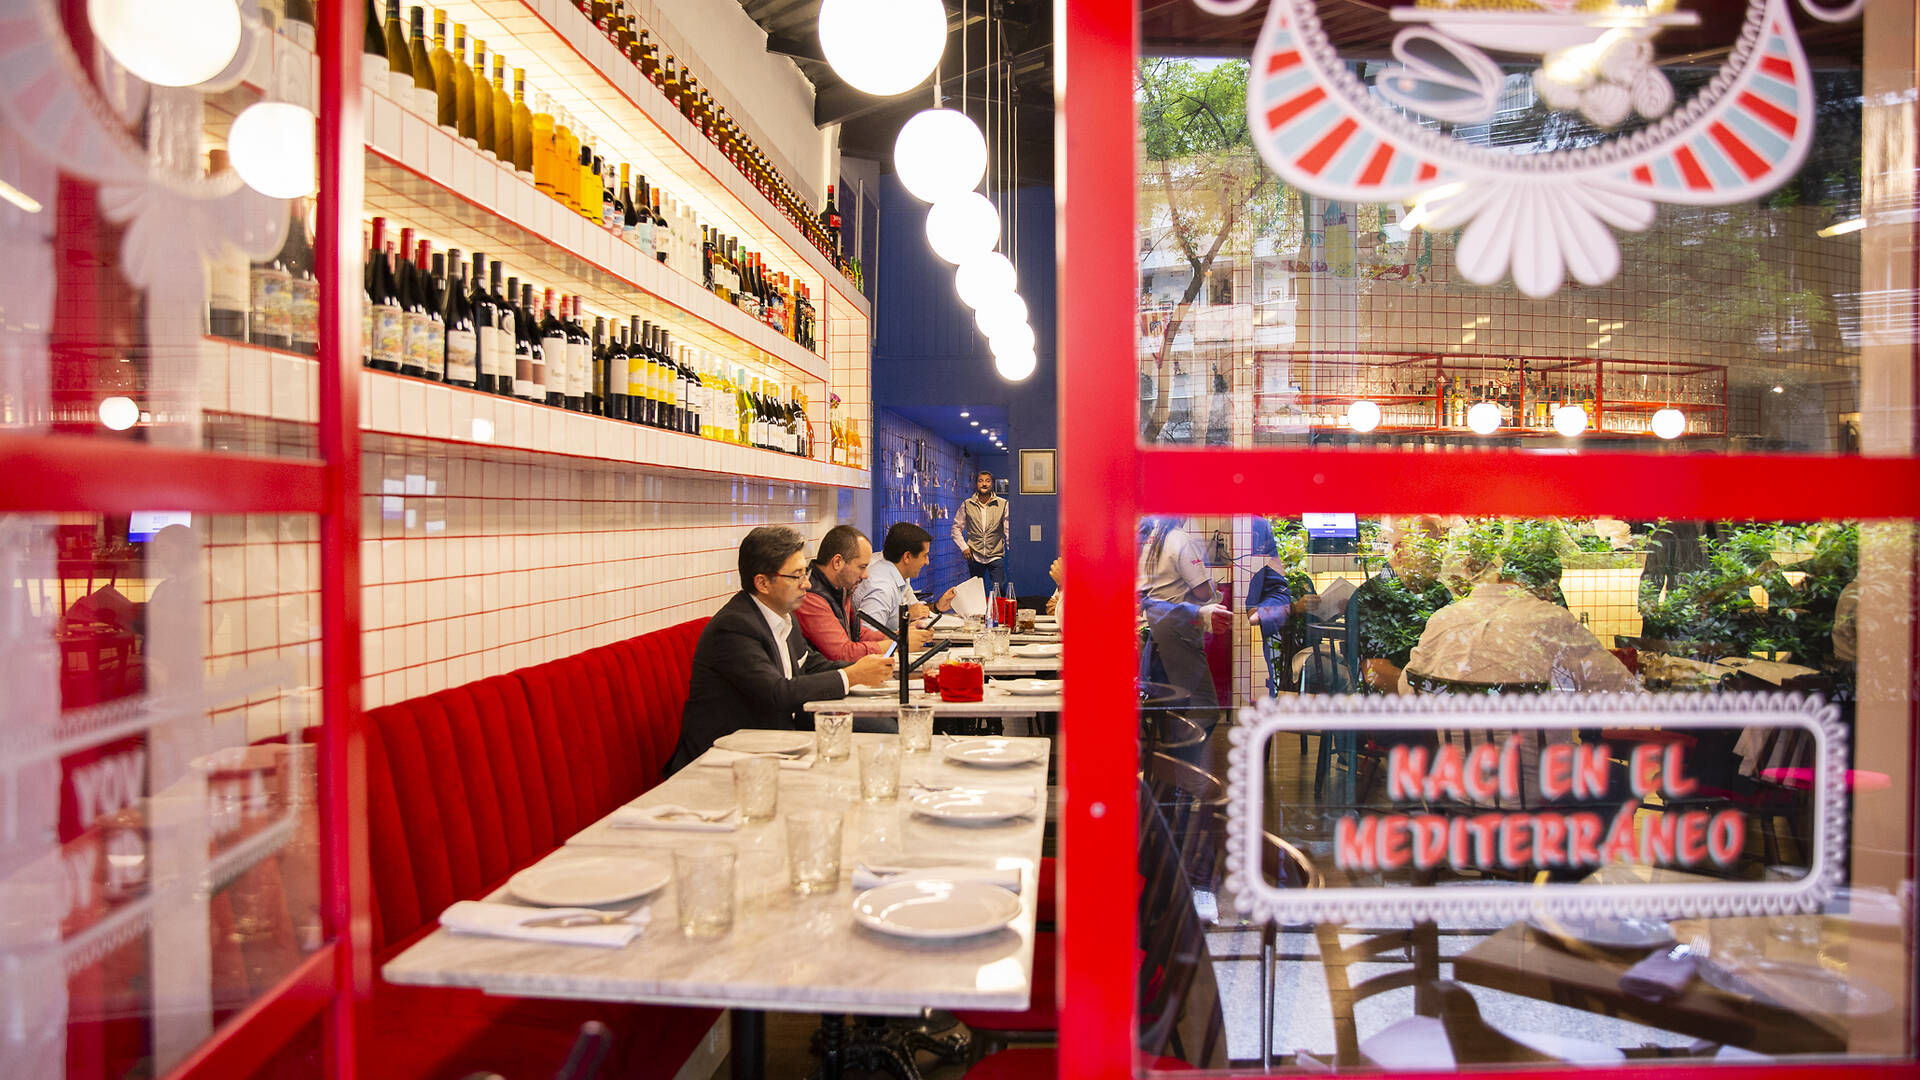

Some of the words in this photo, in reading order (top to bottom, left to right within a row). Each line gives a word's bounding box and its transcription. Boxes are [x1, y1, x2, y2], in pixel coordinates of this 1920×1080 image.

[1387, 734, 1522, 799] NACÍ
[1540, 743, 1611, 798] EN
[1631, 742, 1697, 798] EL
[1334, 801, 1746, 871] MEDITERRÁNEO
